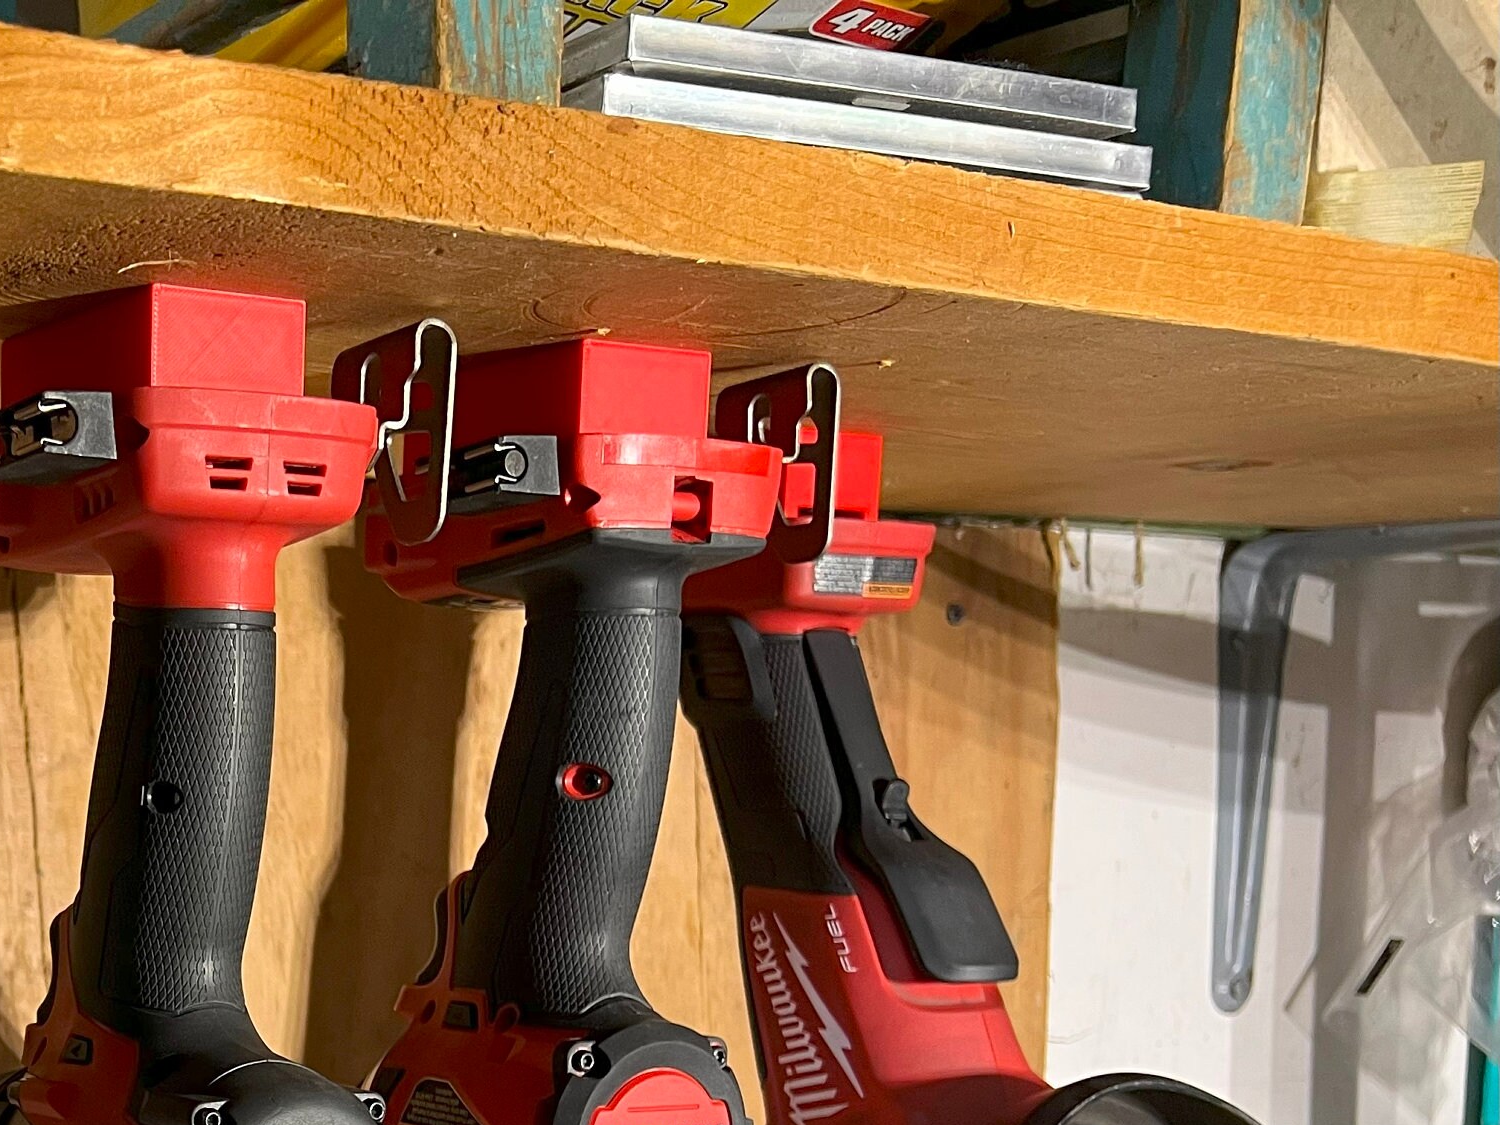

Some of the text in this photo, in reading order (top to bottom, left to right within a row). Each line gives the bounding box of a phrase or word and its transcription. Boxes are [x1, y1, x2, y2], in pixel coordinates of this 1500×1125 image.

[828, 8, 917, 43] 4 PACK
[824, 902, 860, 973] FUEL
